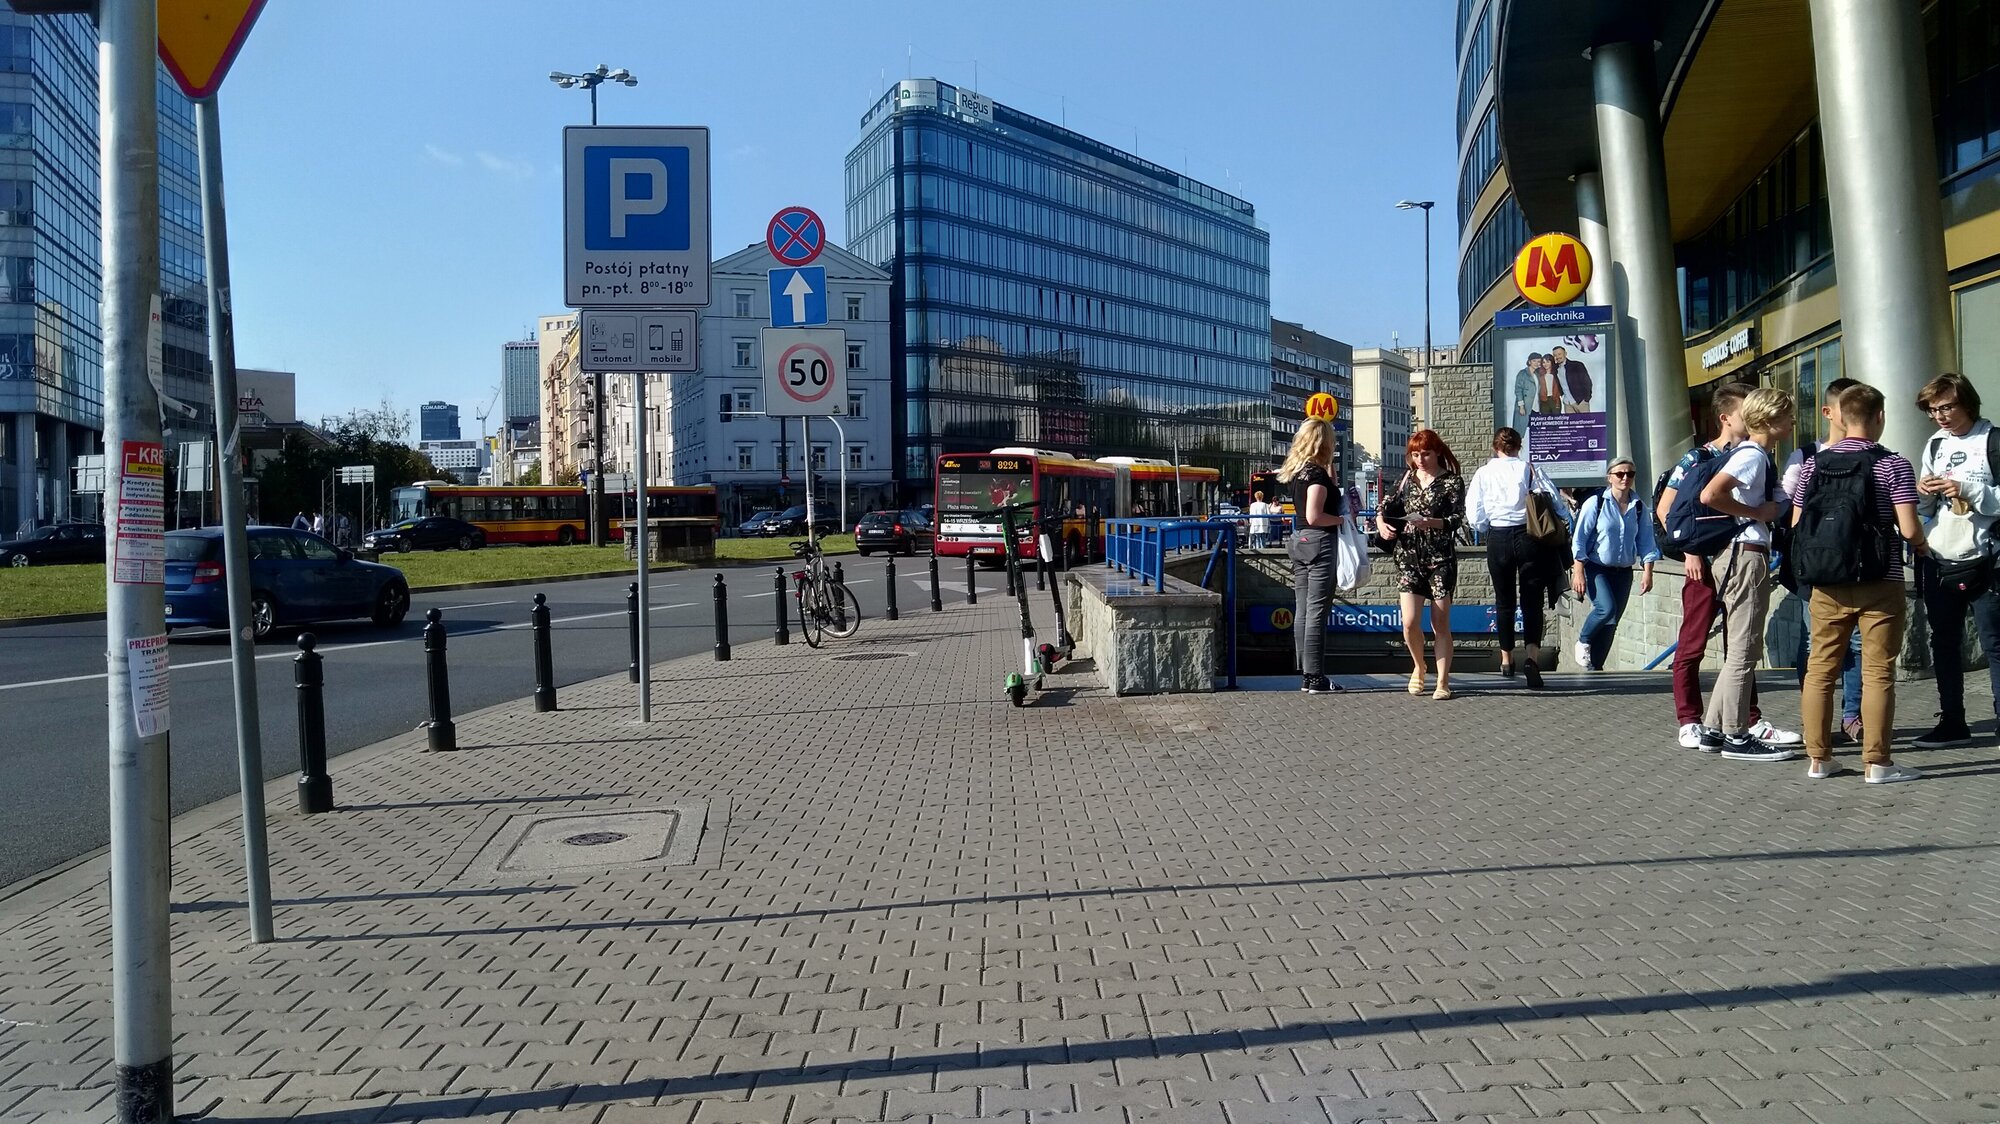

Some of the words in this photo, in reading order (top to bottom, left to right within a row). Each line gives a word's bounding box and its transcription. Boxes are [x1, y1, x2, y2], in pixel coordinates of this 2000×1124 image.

[961, 94, 989, 117] Regus
[609, 157, 668, 238] P
[585, 261, 632, 278] Postój
[639, 261, 689, 278] płatny
[582, 282, 633, 298] pn.-pt.
[1521, 310, 1585, 323] Politechnika
[592, 355, 632, 363] automat
[650, 354, 682, 363] mobile
[790, 358, 828, 386] 50
[1531, 453, 1561, 461] PLAY
[997, 461, 1019, 470] 8224
